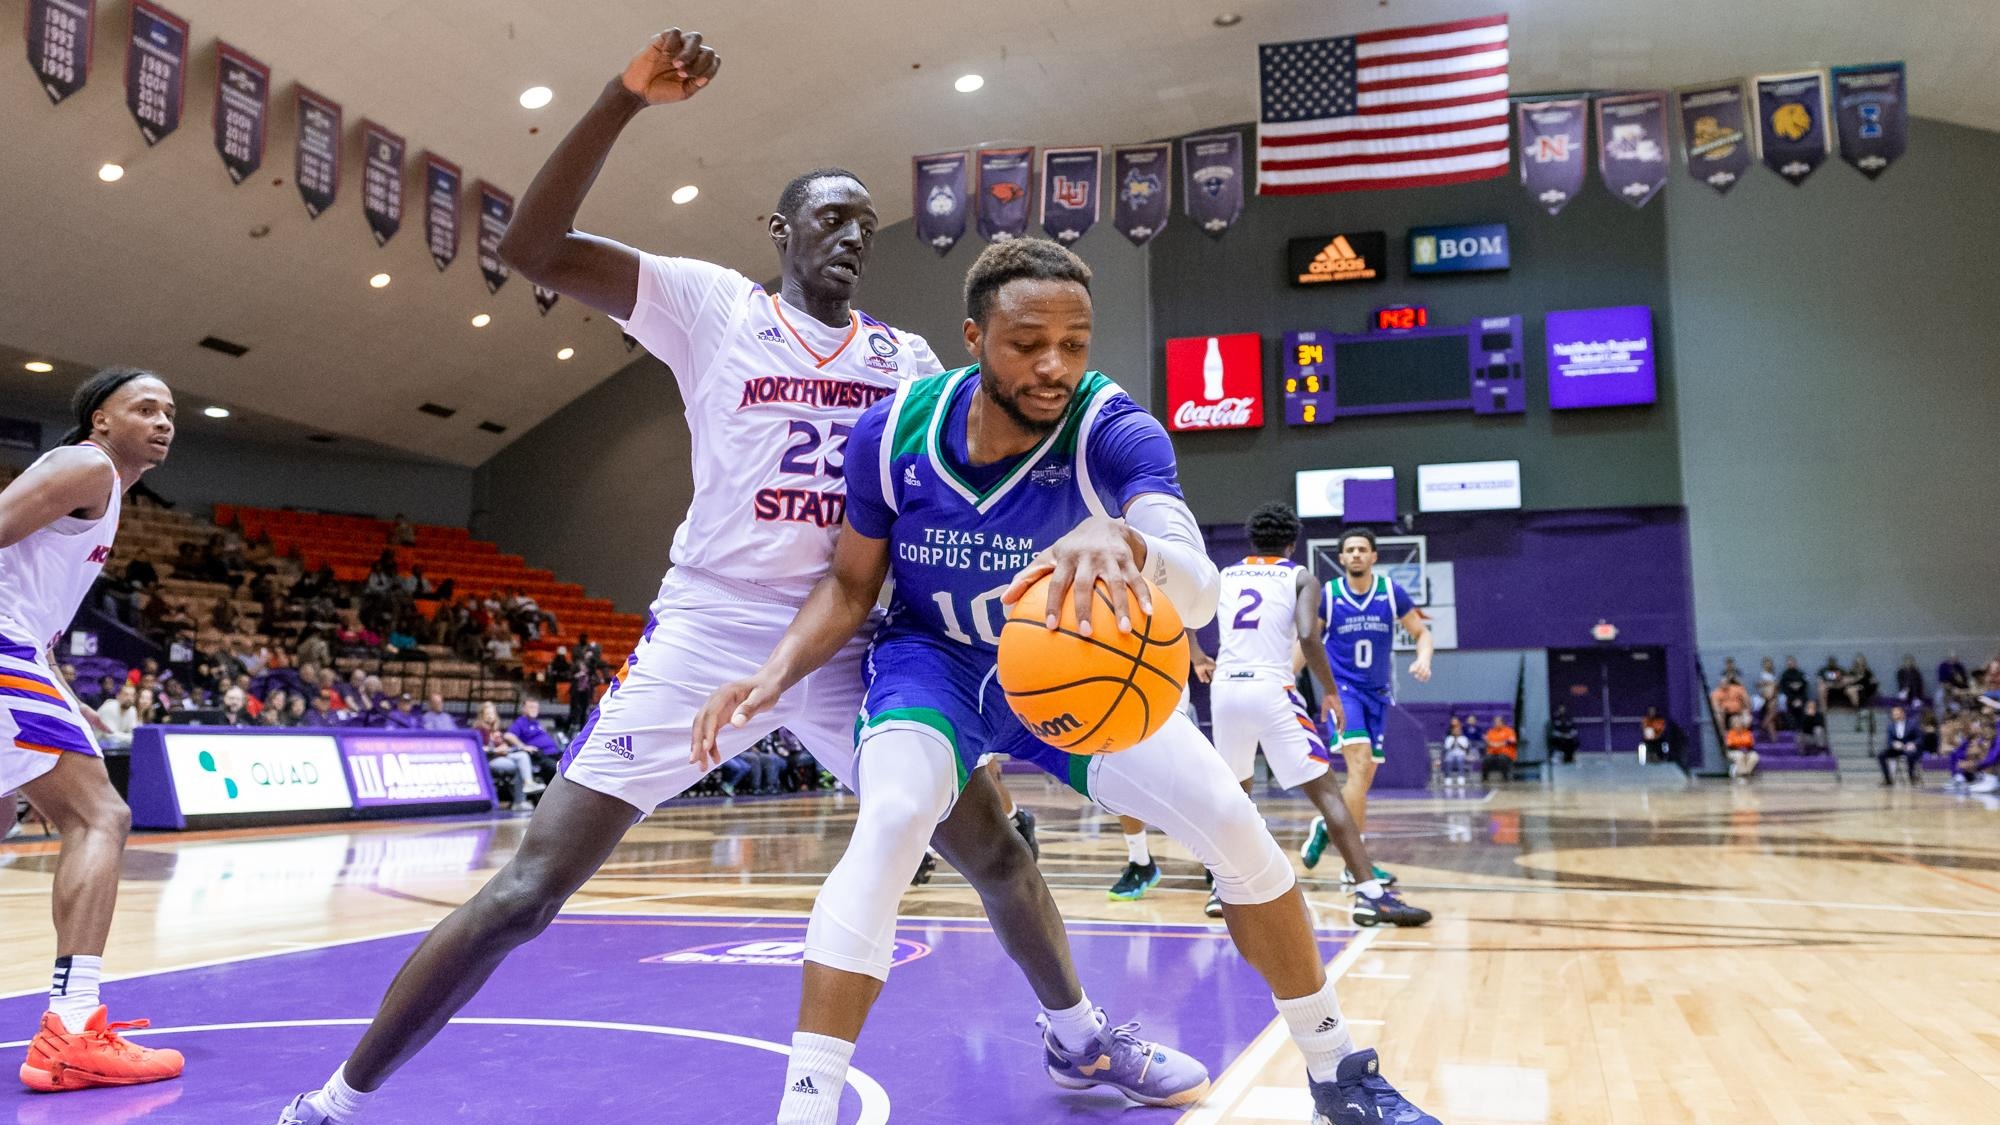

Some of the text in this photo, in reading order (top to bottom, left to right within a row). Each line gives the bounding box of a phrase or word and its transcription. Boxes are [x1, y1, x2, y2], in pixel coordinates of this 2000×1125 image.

[45, 23, 75, 49] 1993
[1053, 176, 1089, 210] LU
[1439, 235, 1503, 259] BOM
[1308, 256, 1366, 274] adidas
[1298, 344, 1324, 366] 34
[1306, 375, 1320, 393] 5
[1303, 405, 1316, 423] 2
[779, 419, 850, 480] 23
[924, 528, 1034, 551] TEXAS A&M
[899, 542, 972, 569] CORPUS
[932, 583, 1016, 646] 10
[1232, 588, 1264, 630] 2
[1354, 639, 1373, 669] 0
[605, 742, 634, 760] adidas
[251, 761, 319, 785] QUAD
[791, 1085, 819, 1095] adidas
